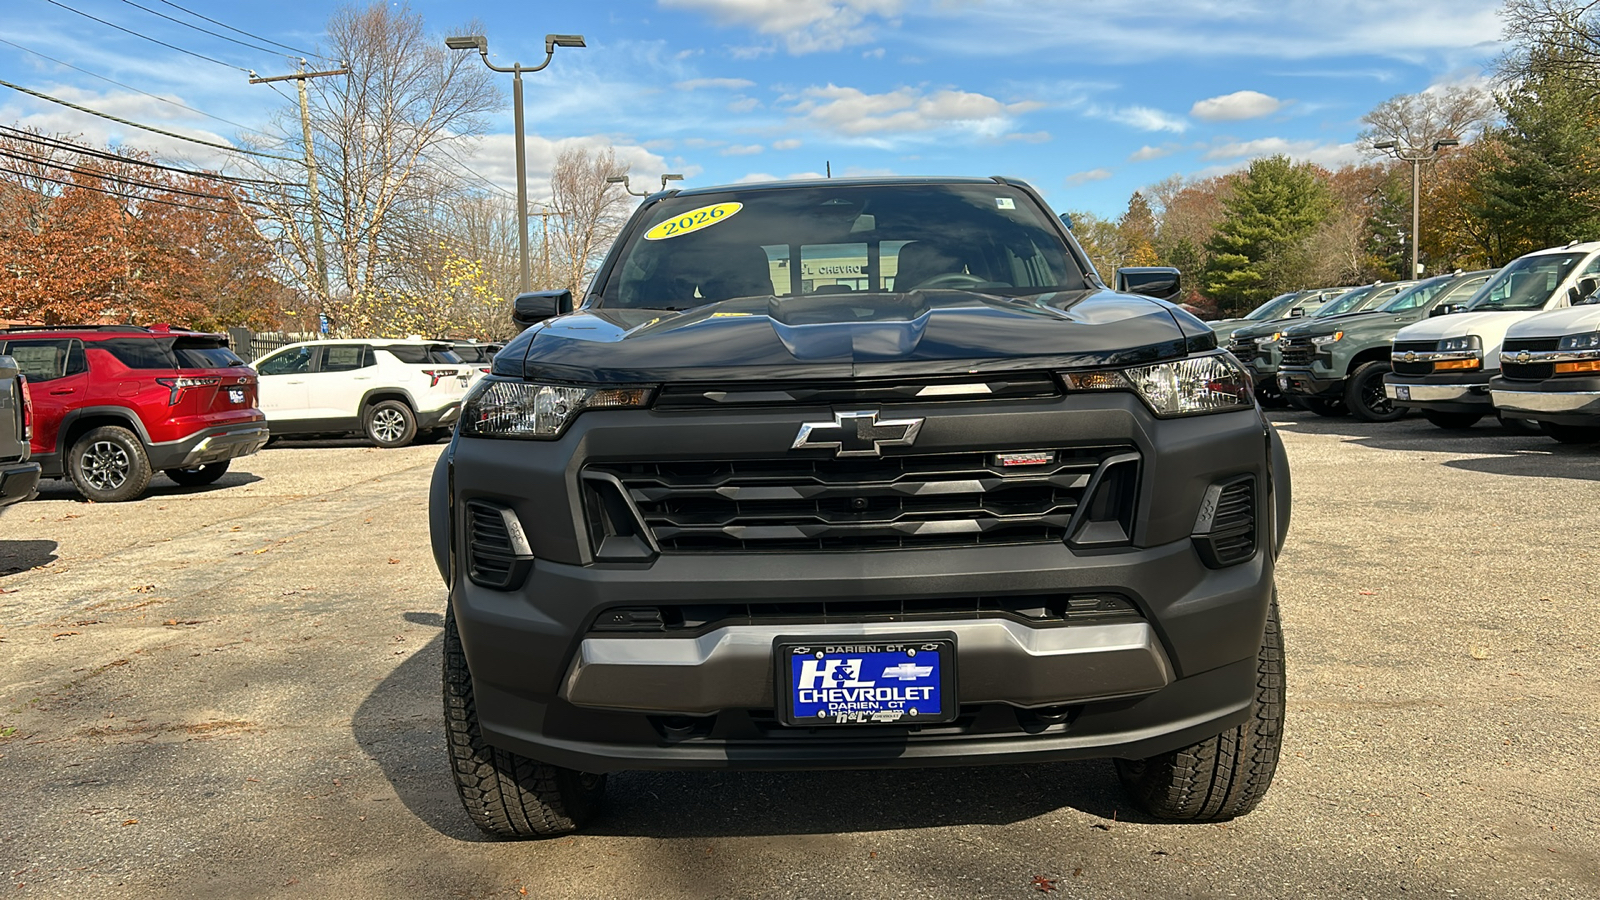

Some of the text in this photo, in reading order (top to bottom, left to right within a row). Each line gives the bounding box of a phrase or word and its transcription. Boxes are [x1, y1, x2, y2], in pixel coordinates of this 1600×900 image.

[663, 206, 725, 236] 2026
[825, 645, 880, 654] DARIEN,
[798, 658, 876, 689] H&L
[799, 686, 935, 703] CHEVROLET
[828, 700, 906, 710] DARIEN, CT
